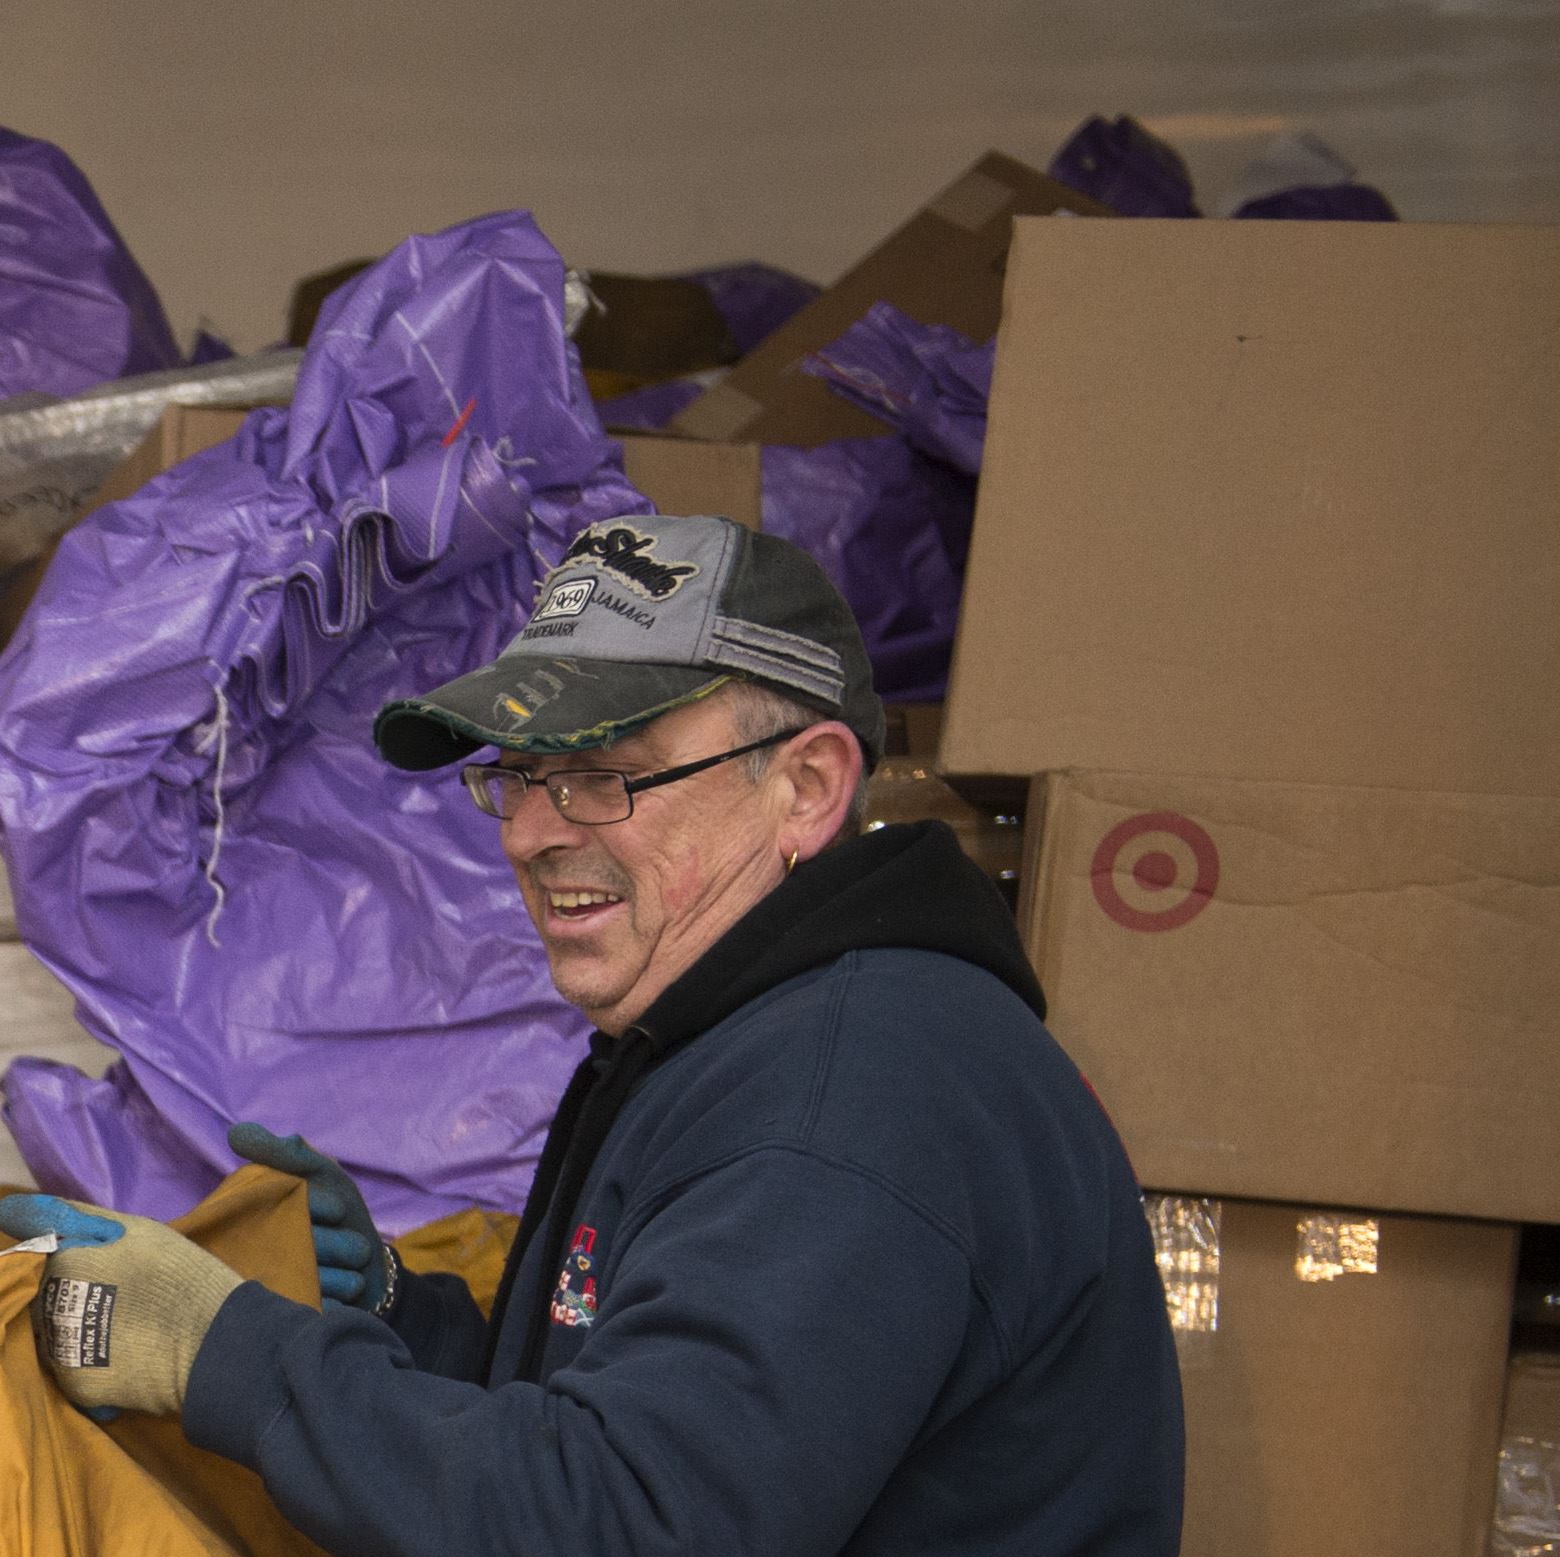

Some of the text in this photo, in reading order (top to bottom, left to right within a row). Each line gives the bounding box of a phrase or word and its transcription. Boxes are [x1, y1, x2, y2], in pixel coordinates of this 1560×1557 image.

[588, 591, 657, 630] JAMAICA
[521, 620, 580, 642] TRADEMARK
[68, 1294, 78, 1313] Size
[83, 1286, 102, 1365] Reflex K Plus
